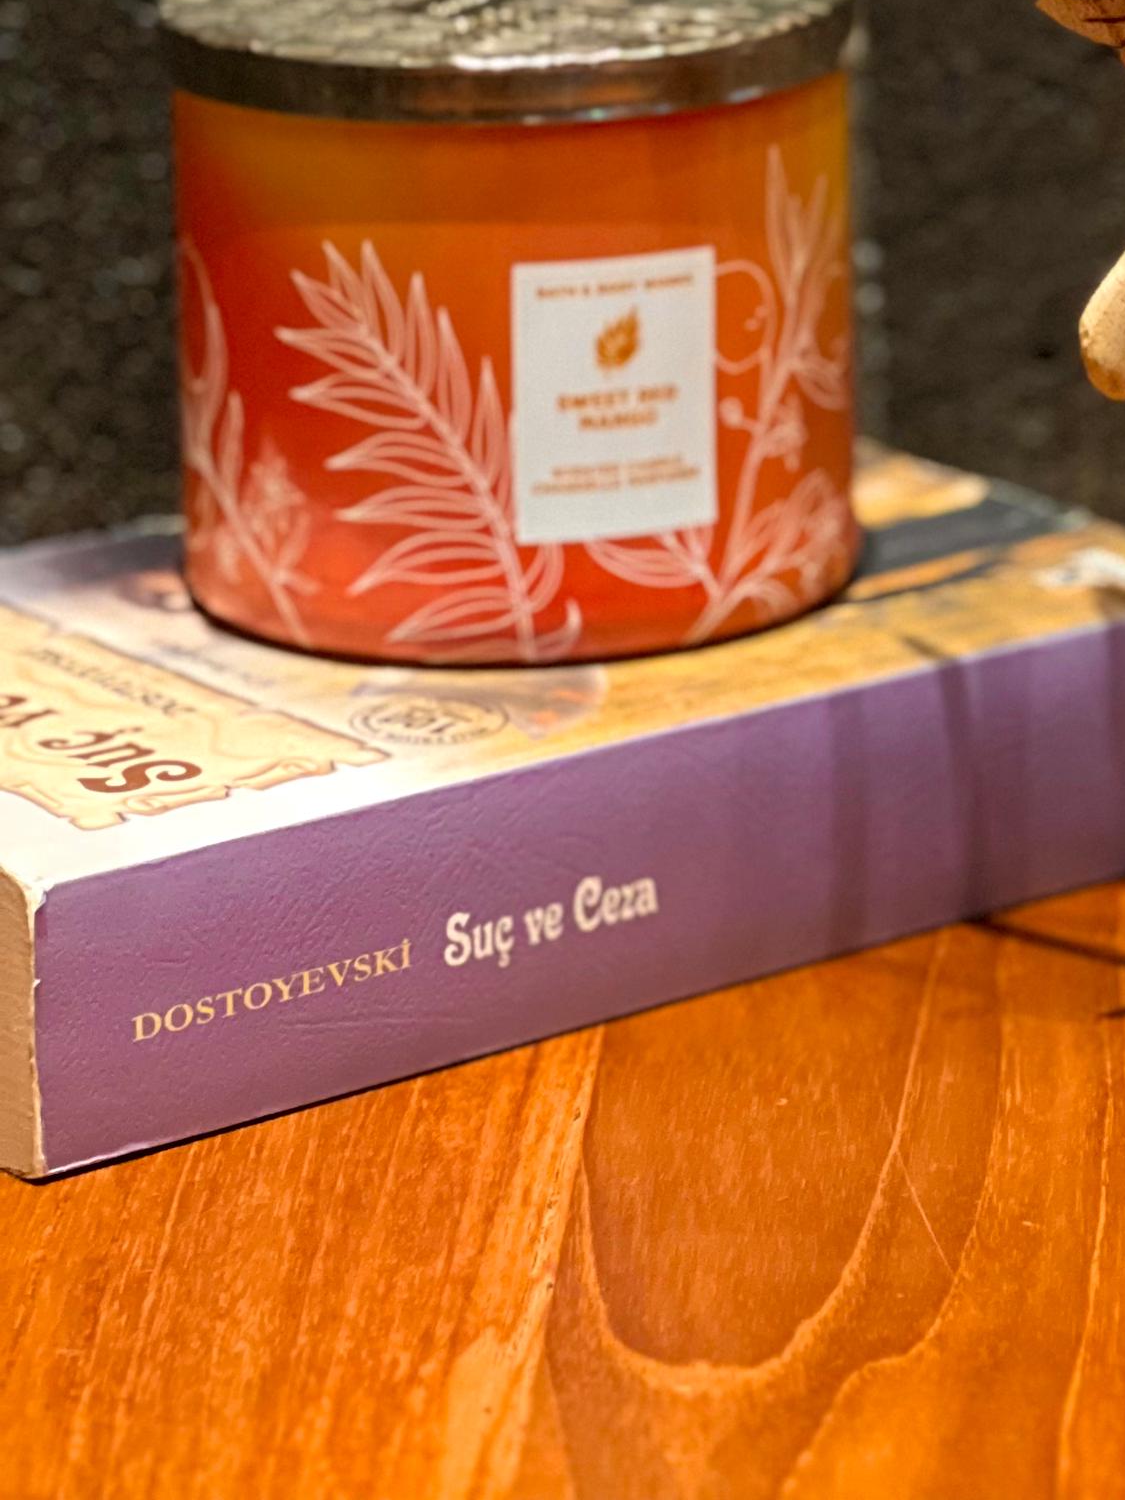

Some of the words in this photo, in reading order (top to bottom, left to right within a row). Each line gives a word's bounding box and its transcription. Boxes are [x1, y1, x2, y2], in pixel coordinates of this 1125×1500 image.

[37, 726, 203, 794] Suç
[443, 911, 515, 968] Suç
[523, 901, 564, 946] ve
[573, 875, 660, 933] Ceza
[131, 936, 413, 1044] DOSTOYEVSKİ
